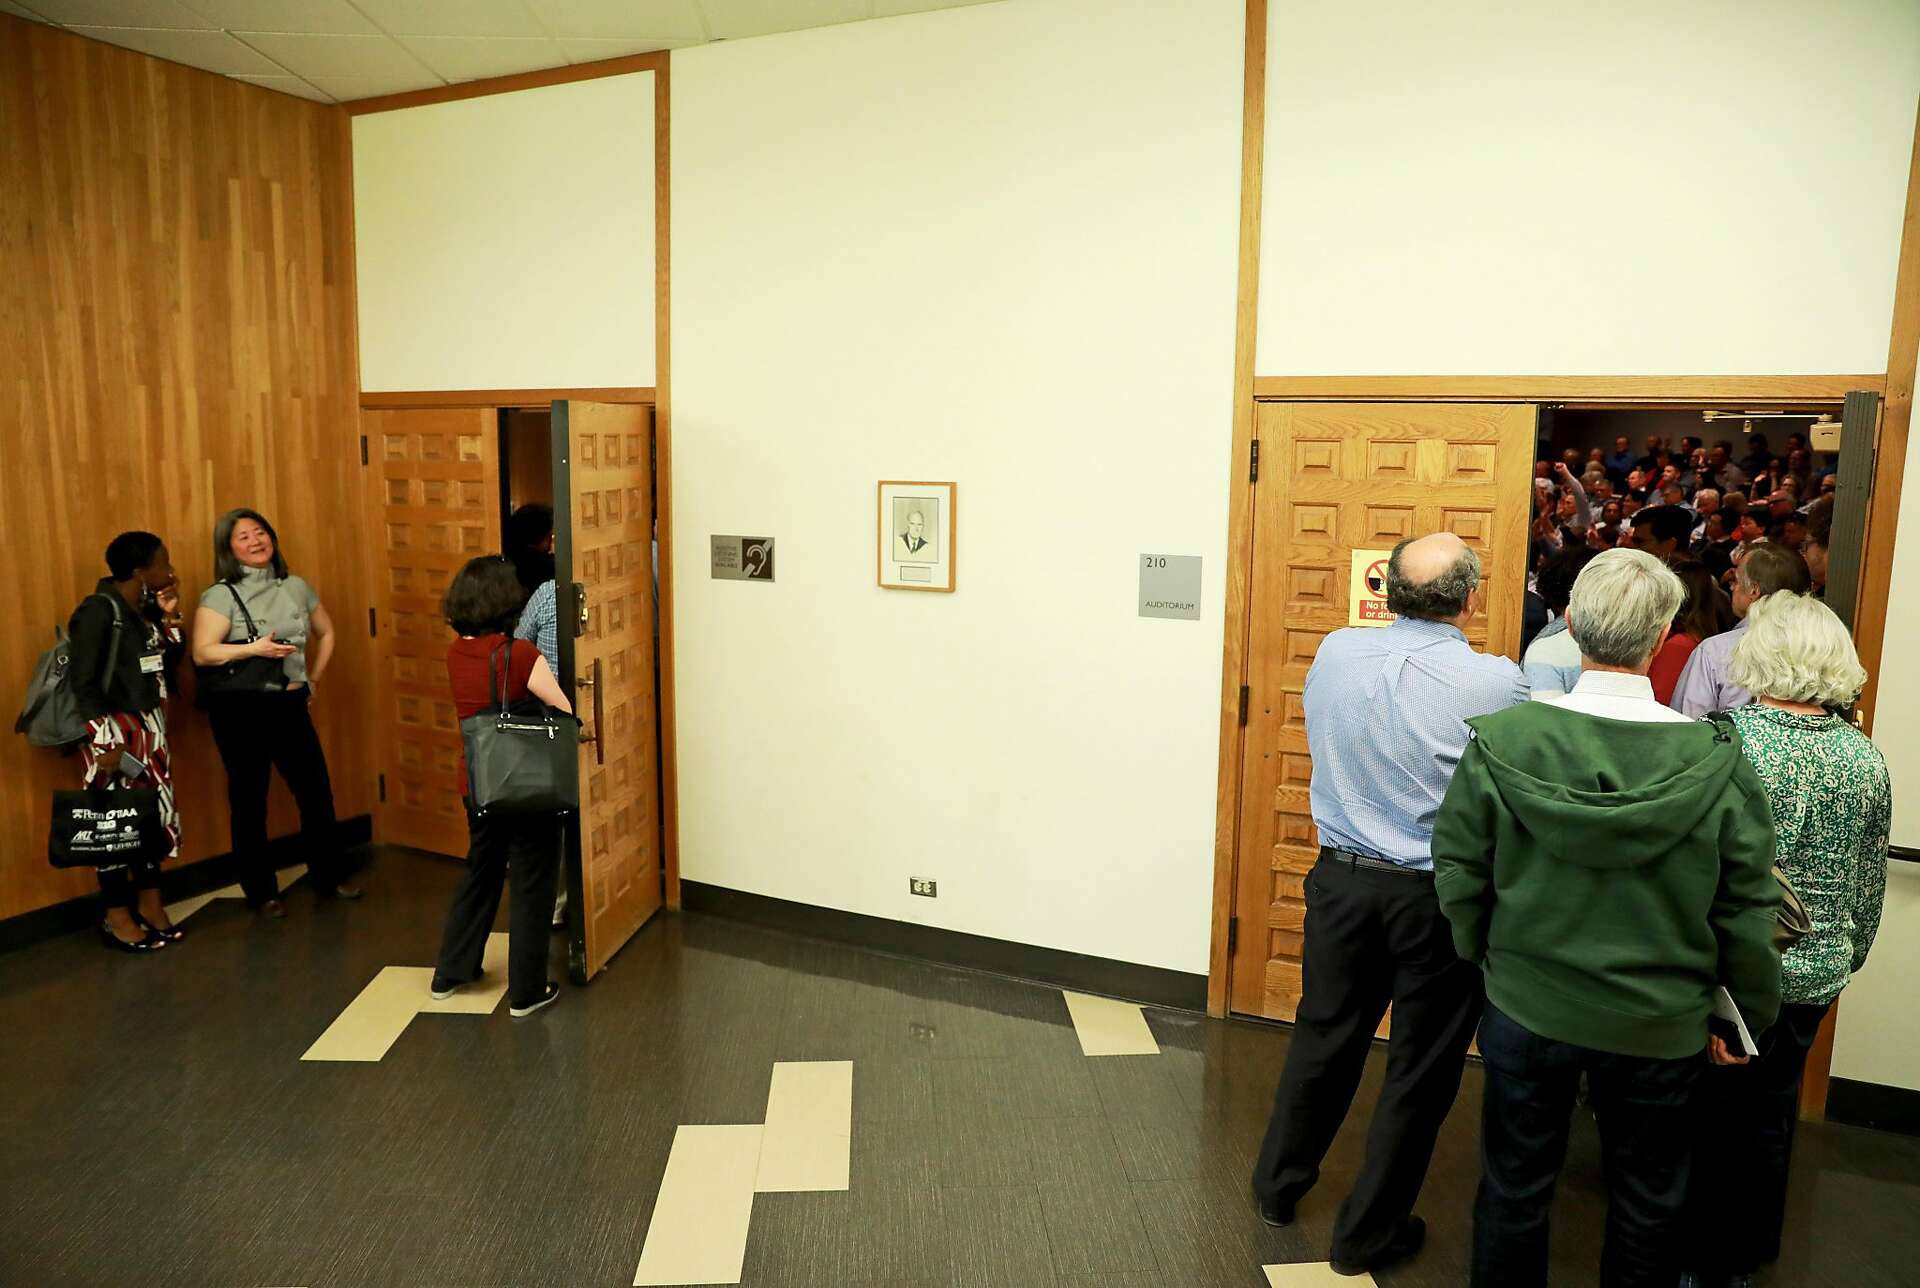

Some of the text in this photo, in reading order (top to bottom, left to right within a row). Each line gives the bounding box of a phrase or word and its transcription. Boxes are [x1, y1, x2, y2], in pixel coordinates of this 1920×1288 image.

[1146, 557, 1166, 568] 210
[1145, 601, 1194, 610] AUDITORIUM
[1366, 601, 1379, 610] No
[83, 808, 105, 820] Penn
